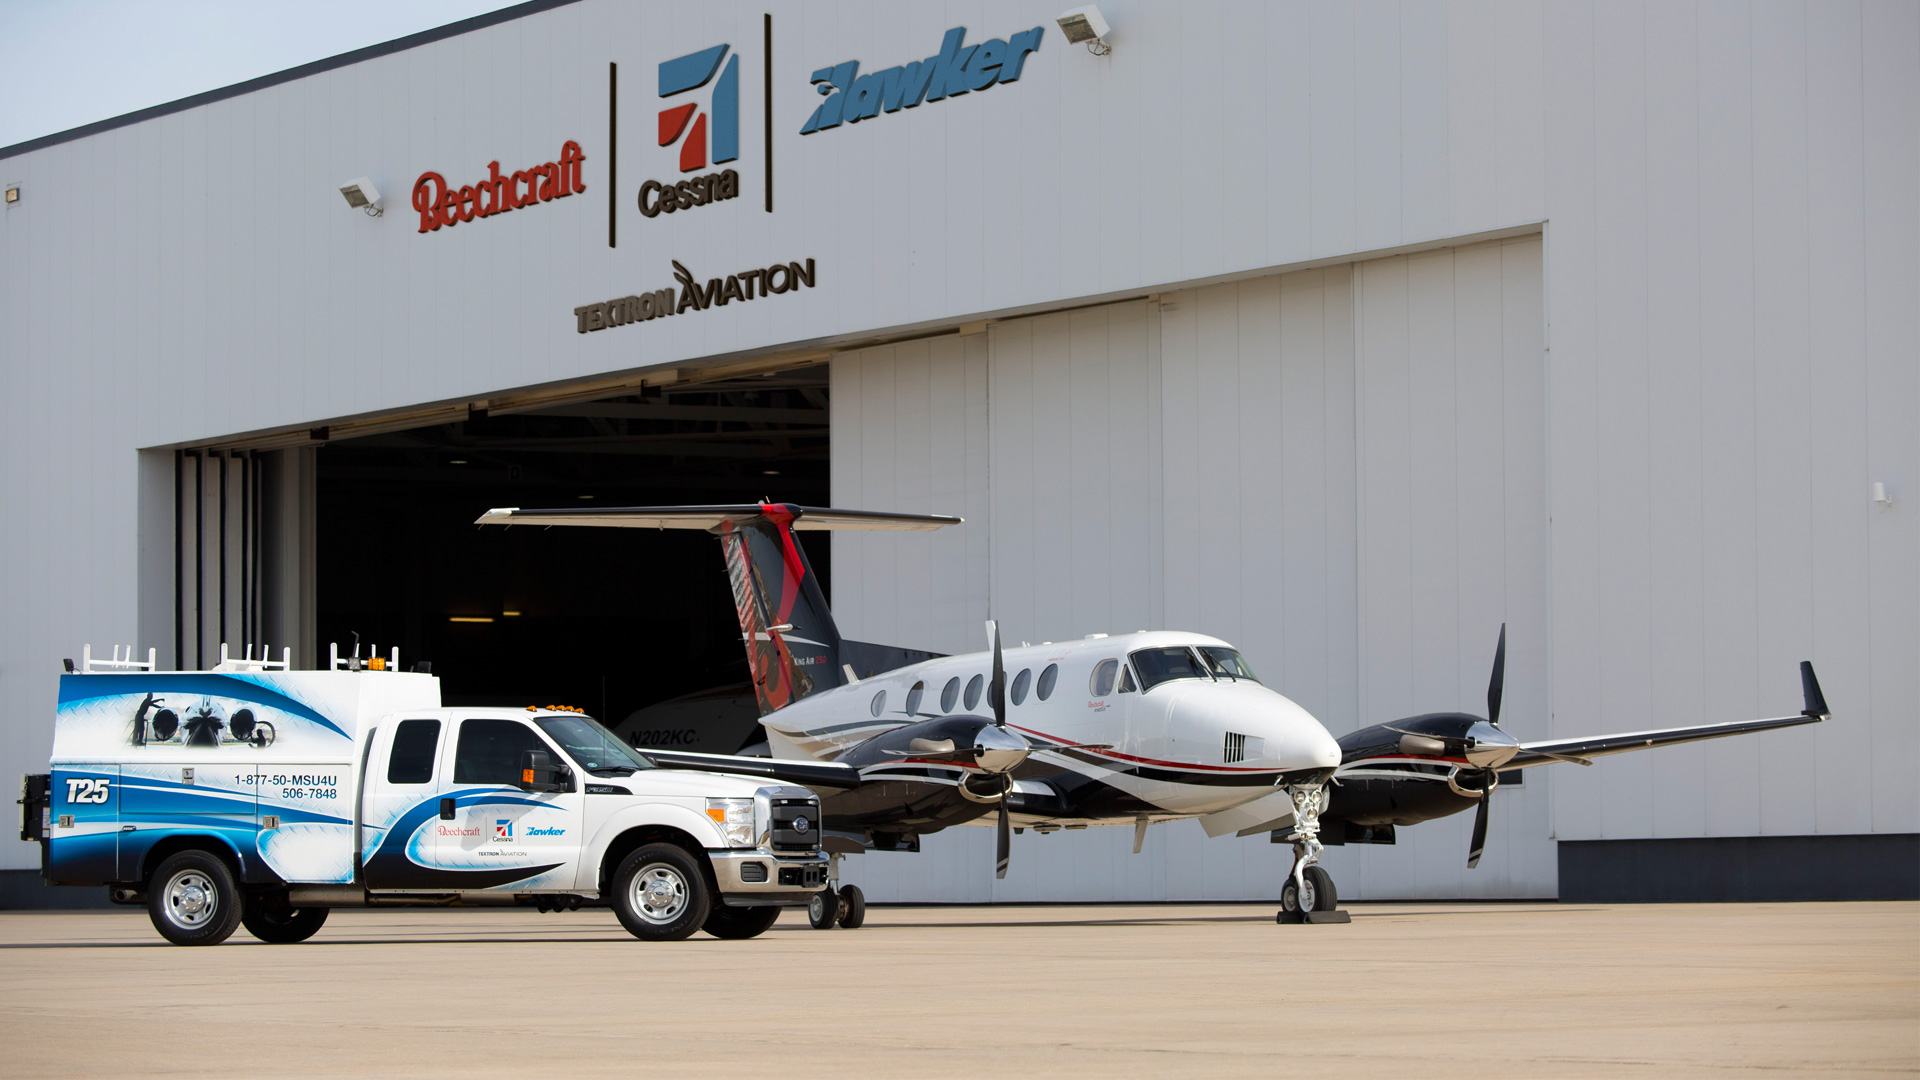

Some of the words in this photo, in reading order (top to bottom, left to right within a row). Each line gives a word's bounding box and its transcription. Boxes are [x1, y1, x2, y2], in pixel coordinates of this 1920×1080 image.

[799, 26, 1045, 136] Hawker
[412, 140, 586, 233] Beechcraft
[638, 169, 739, 218] Cessna
[574, 287, 675, 334] TEXTRON
[671, 257, 816, 315] AVIATION
[815, 655, 827, 665] 250
[629, 729, 697, 745] N202KC
[234, 774, 337, 786] 1-877-50-MSU4U
[66, 778, 110, 804] T25
[282, 788, 337, 800] 506-7848
[438, 825, 480, 836] Beechcraft
[525, 826, 566, 836] Hawker
